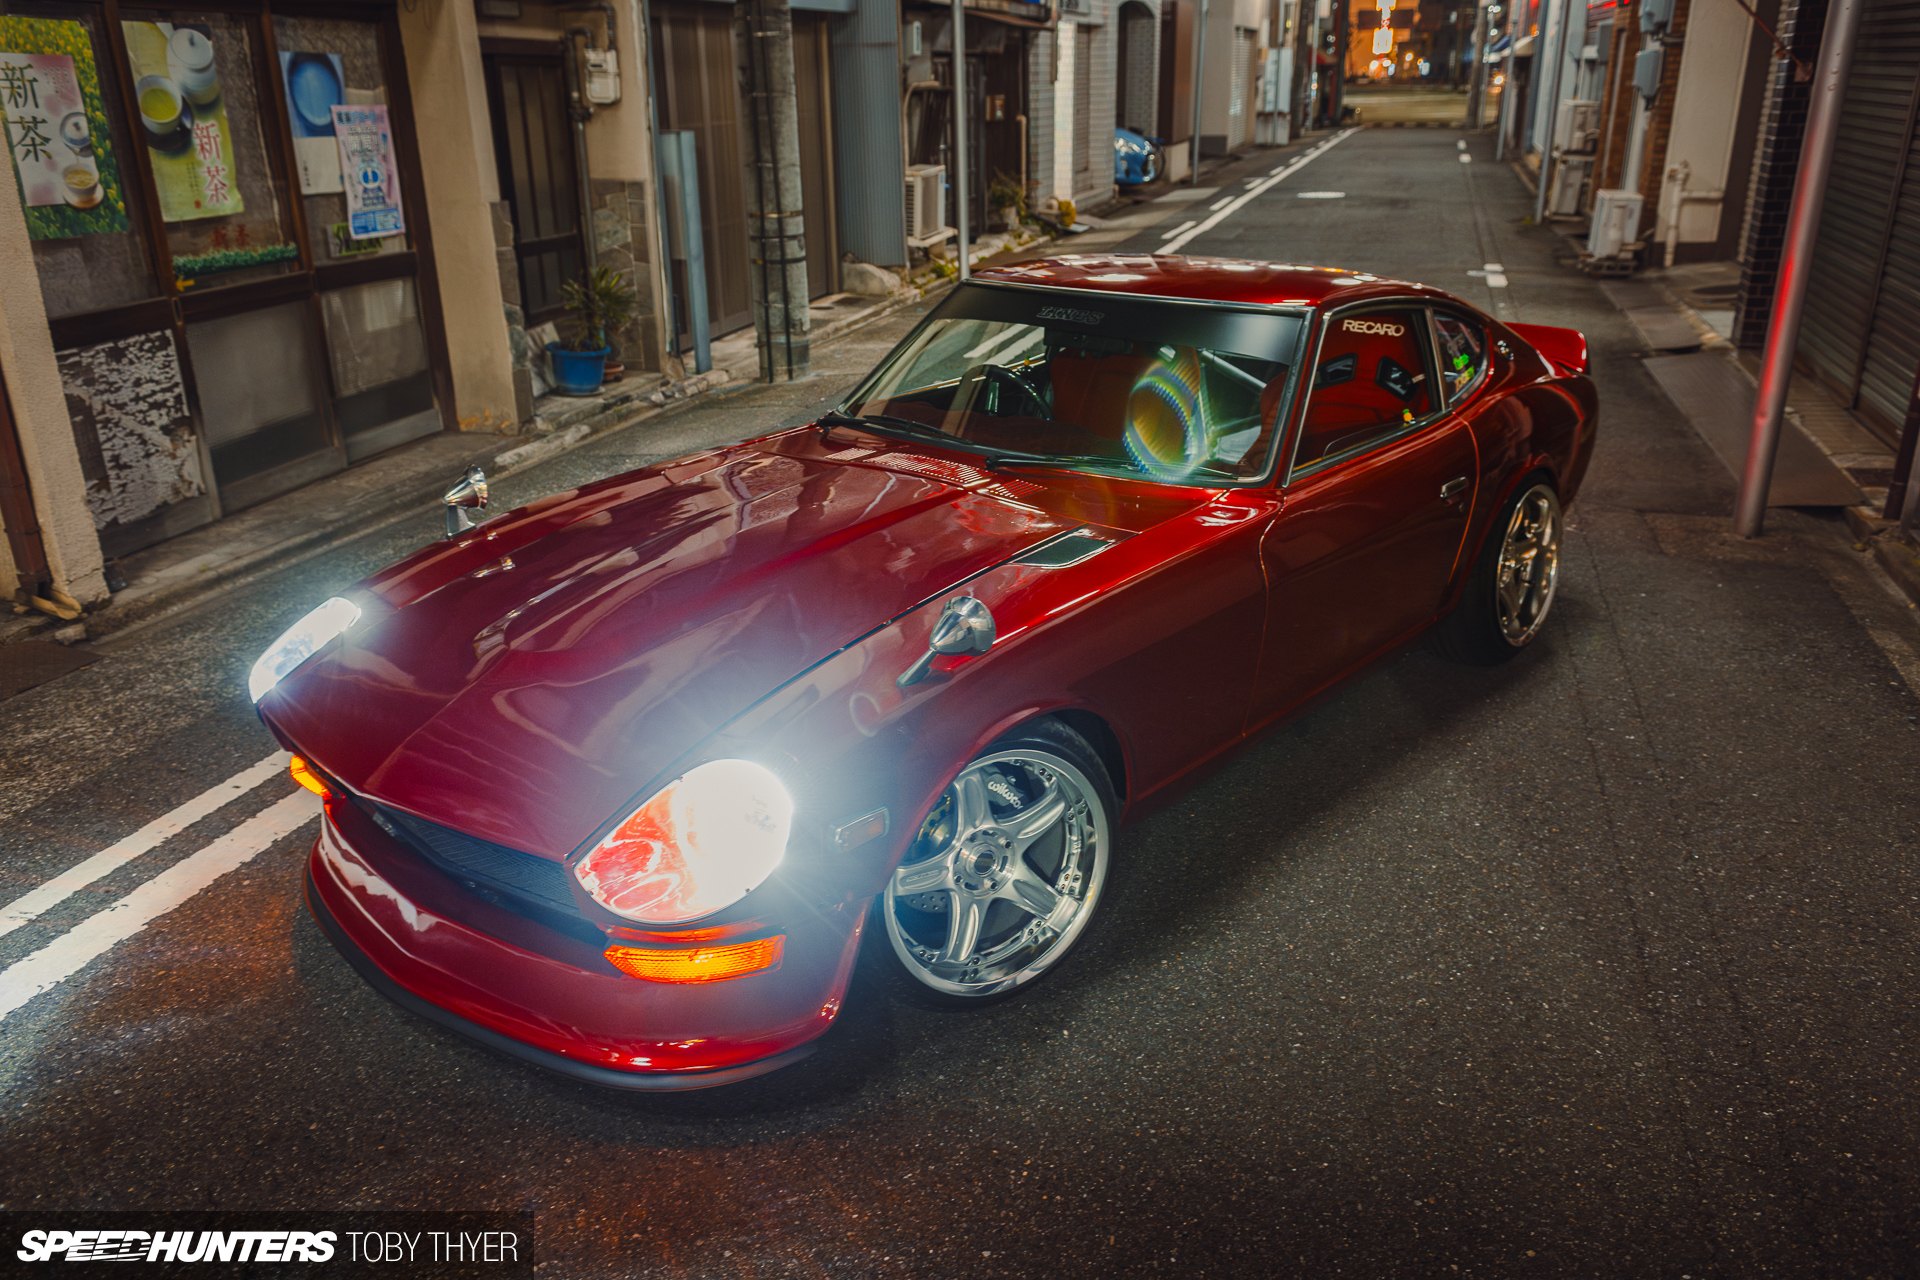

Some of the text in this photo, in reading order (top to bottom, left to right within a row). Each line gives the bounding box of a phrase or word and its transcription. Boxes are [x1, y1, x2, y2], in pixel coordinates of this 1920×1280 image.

[0, 60, 53, 163] 新茶
[192, 121, 230, 206] 新茶
[1342, 319, 1405, 337] RECARO
[987, 781, 1024, 810] wilwoo
